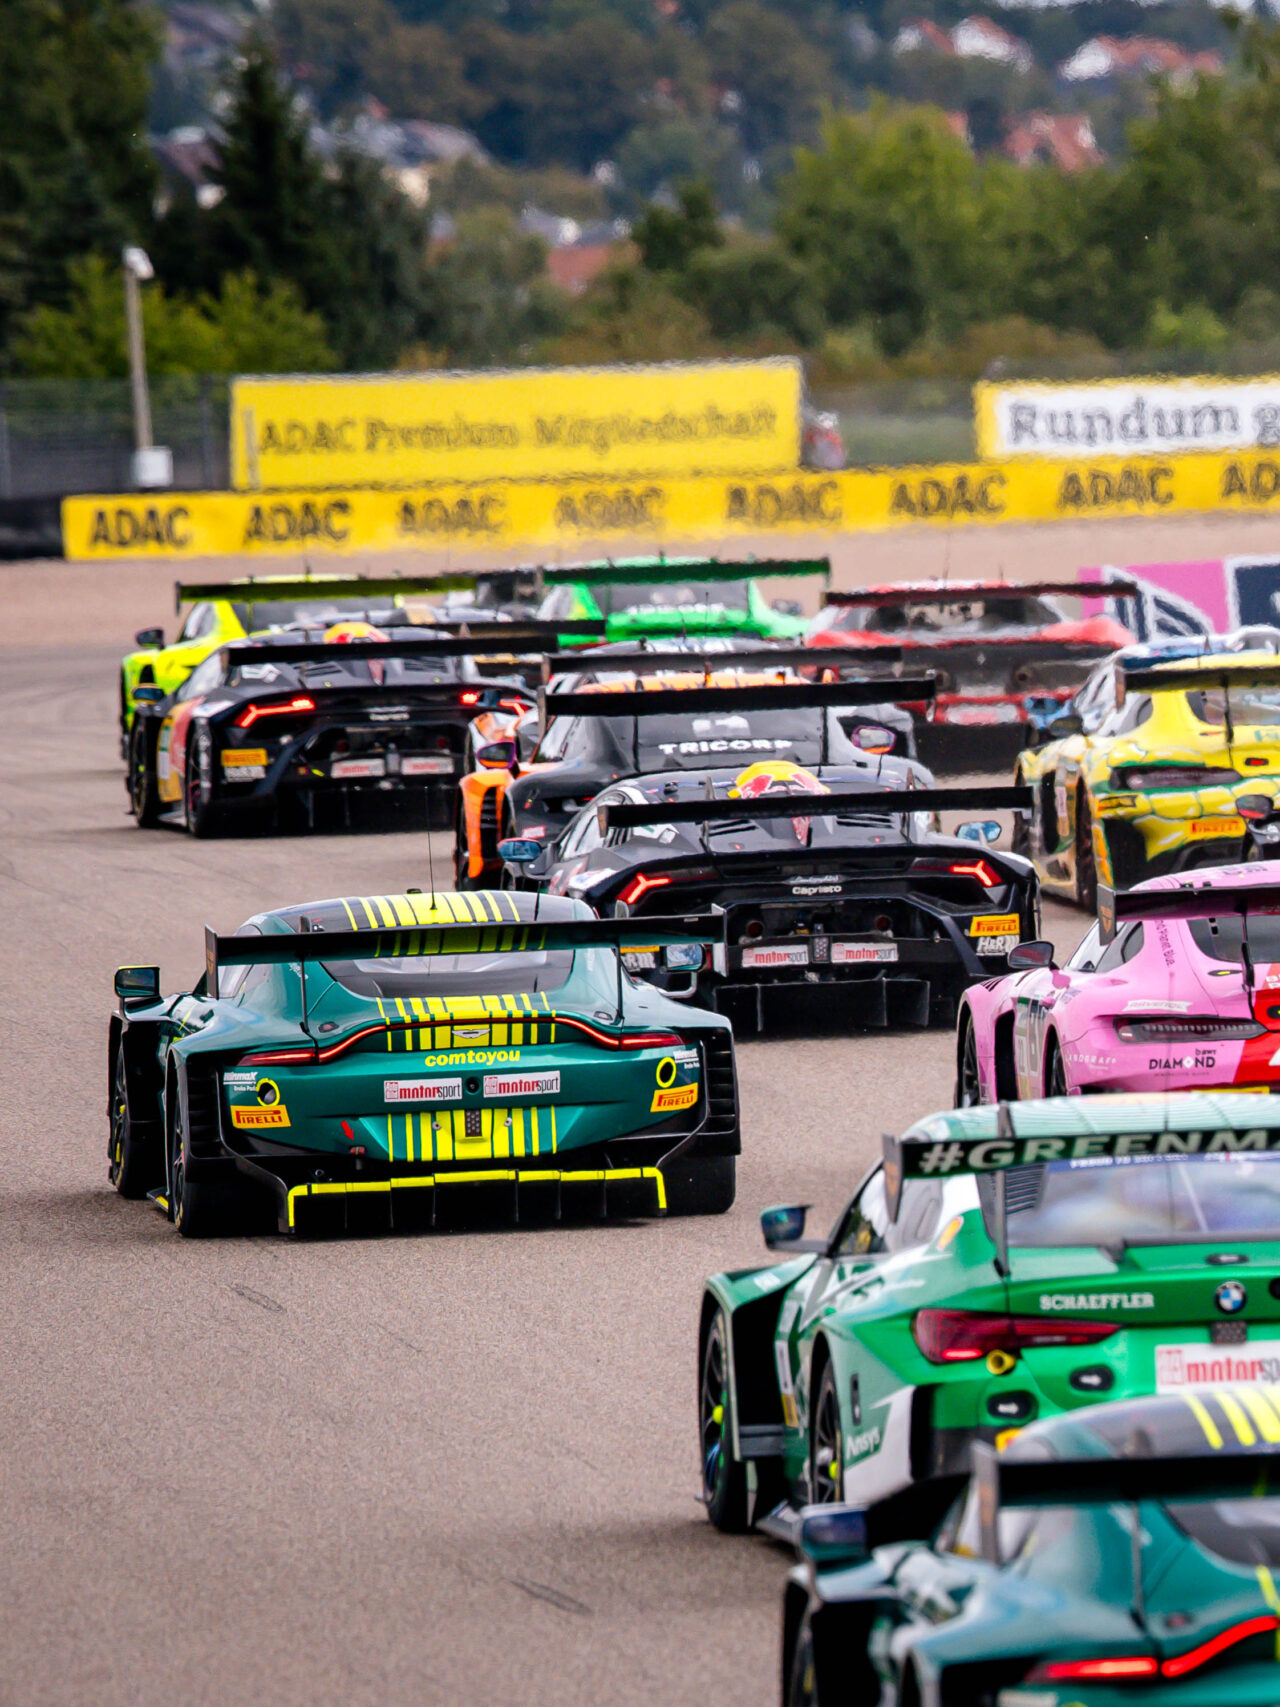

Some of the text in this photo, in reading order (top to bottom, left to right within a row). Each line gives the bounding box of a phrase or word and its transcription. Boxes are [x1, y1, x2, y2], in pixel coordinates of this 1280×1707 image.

[1007, 395, 1241, 445] Rundum
[261, 418, 356, 454] ADAC
[890, 470, 1007, 514] ADAC
[1058, 464, 1175, 510] ADAC
[726, 479, 842, 526] ADAC
[89, 506, 191, 547] ADAC
[246, 499, 350, 541] ADAC
[658, 738, 793, 755] TRICORP
[976, 919, 1017, 932] PIRELLI
[424, 1049, 521, 1067] comtoyou
[1148, 1055, 1216, 1070] DIAMOND
[400, 1083, 461, 1100] motorsport
[499, 1076, 559, 1094] motorsport
[656, 1089, 694, 1107] PIRELLI
[235, 1110, 283, 1124] PIRELLI
[1039, 1291, 1155, 1311] SCHAEFFLER
